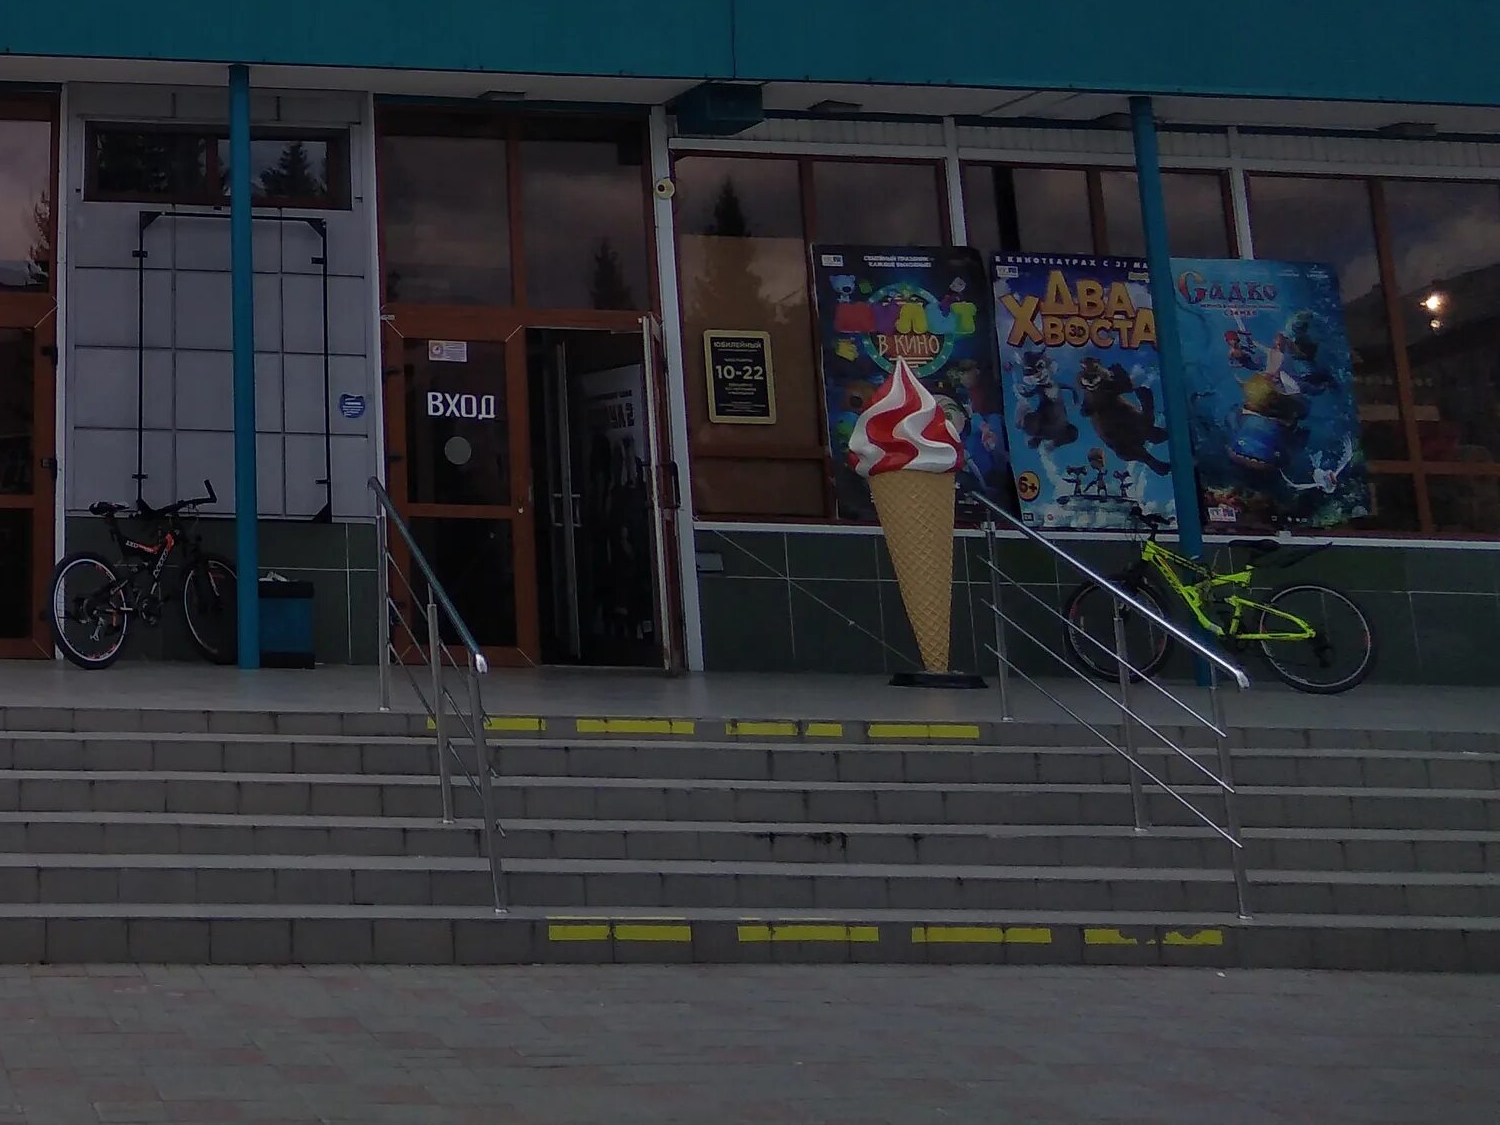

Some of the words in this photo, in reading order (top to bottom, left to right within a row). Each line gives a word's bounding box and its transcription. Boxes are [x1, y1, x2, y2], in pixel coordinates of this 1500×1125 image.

[1007, 255, 1097, 267] КИНОТЕАТРАХ
[1040, 268, 1137, 318] ДВА
[998, 292, 1158, 350] ХВОСТА
[1068, 323, 1087, 338] 3D
[877, 335, 890, 357] В
[894, 334, 941, 356] КИНО
[715, 364, 764, 381] 10-22
[426, 391, 497, 421] ВХОД
[1017, 475, 1038, 494] 6+
